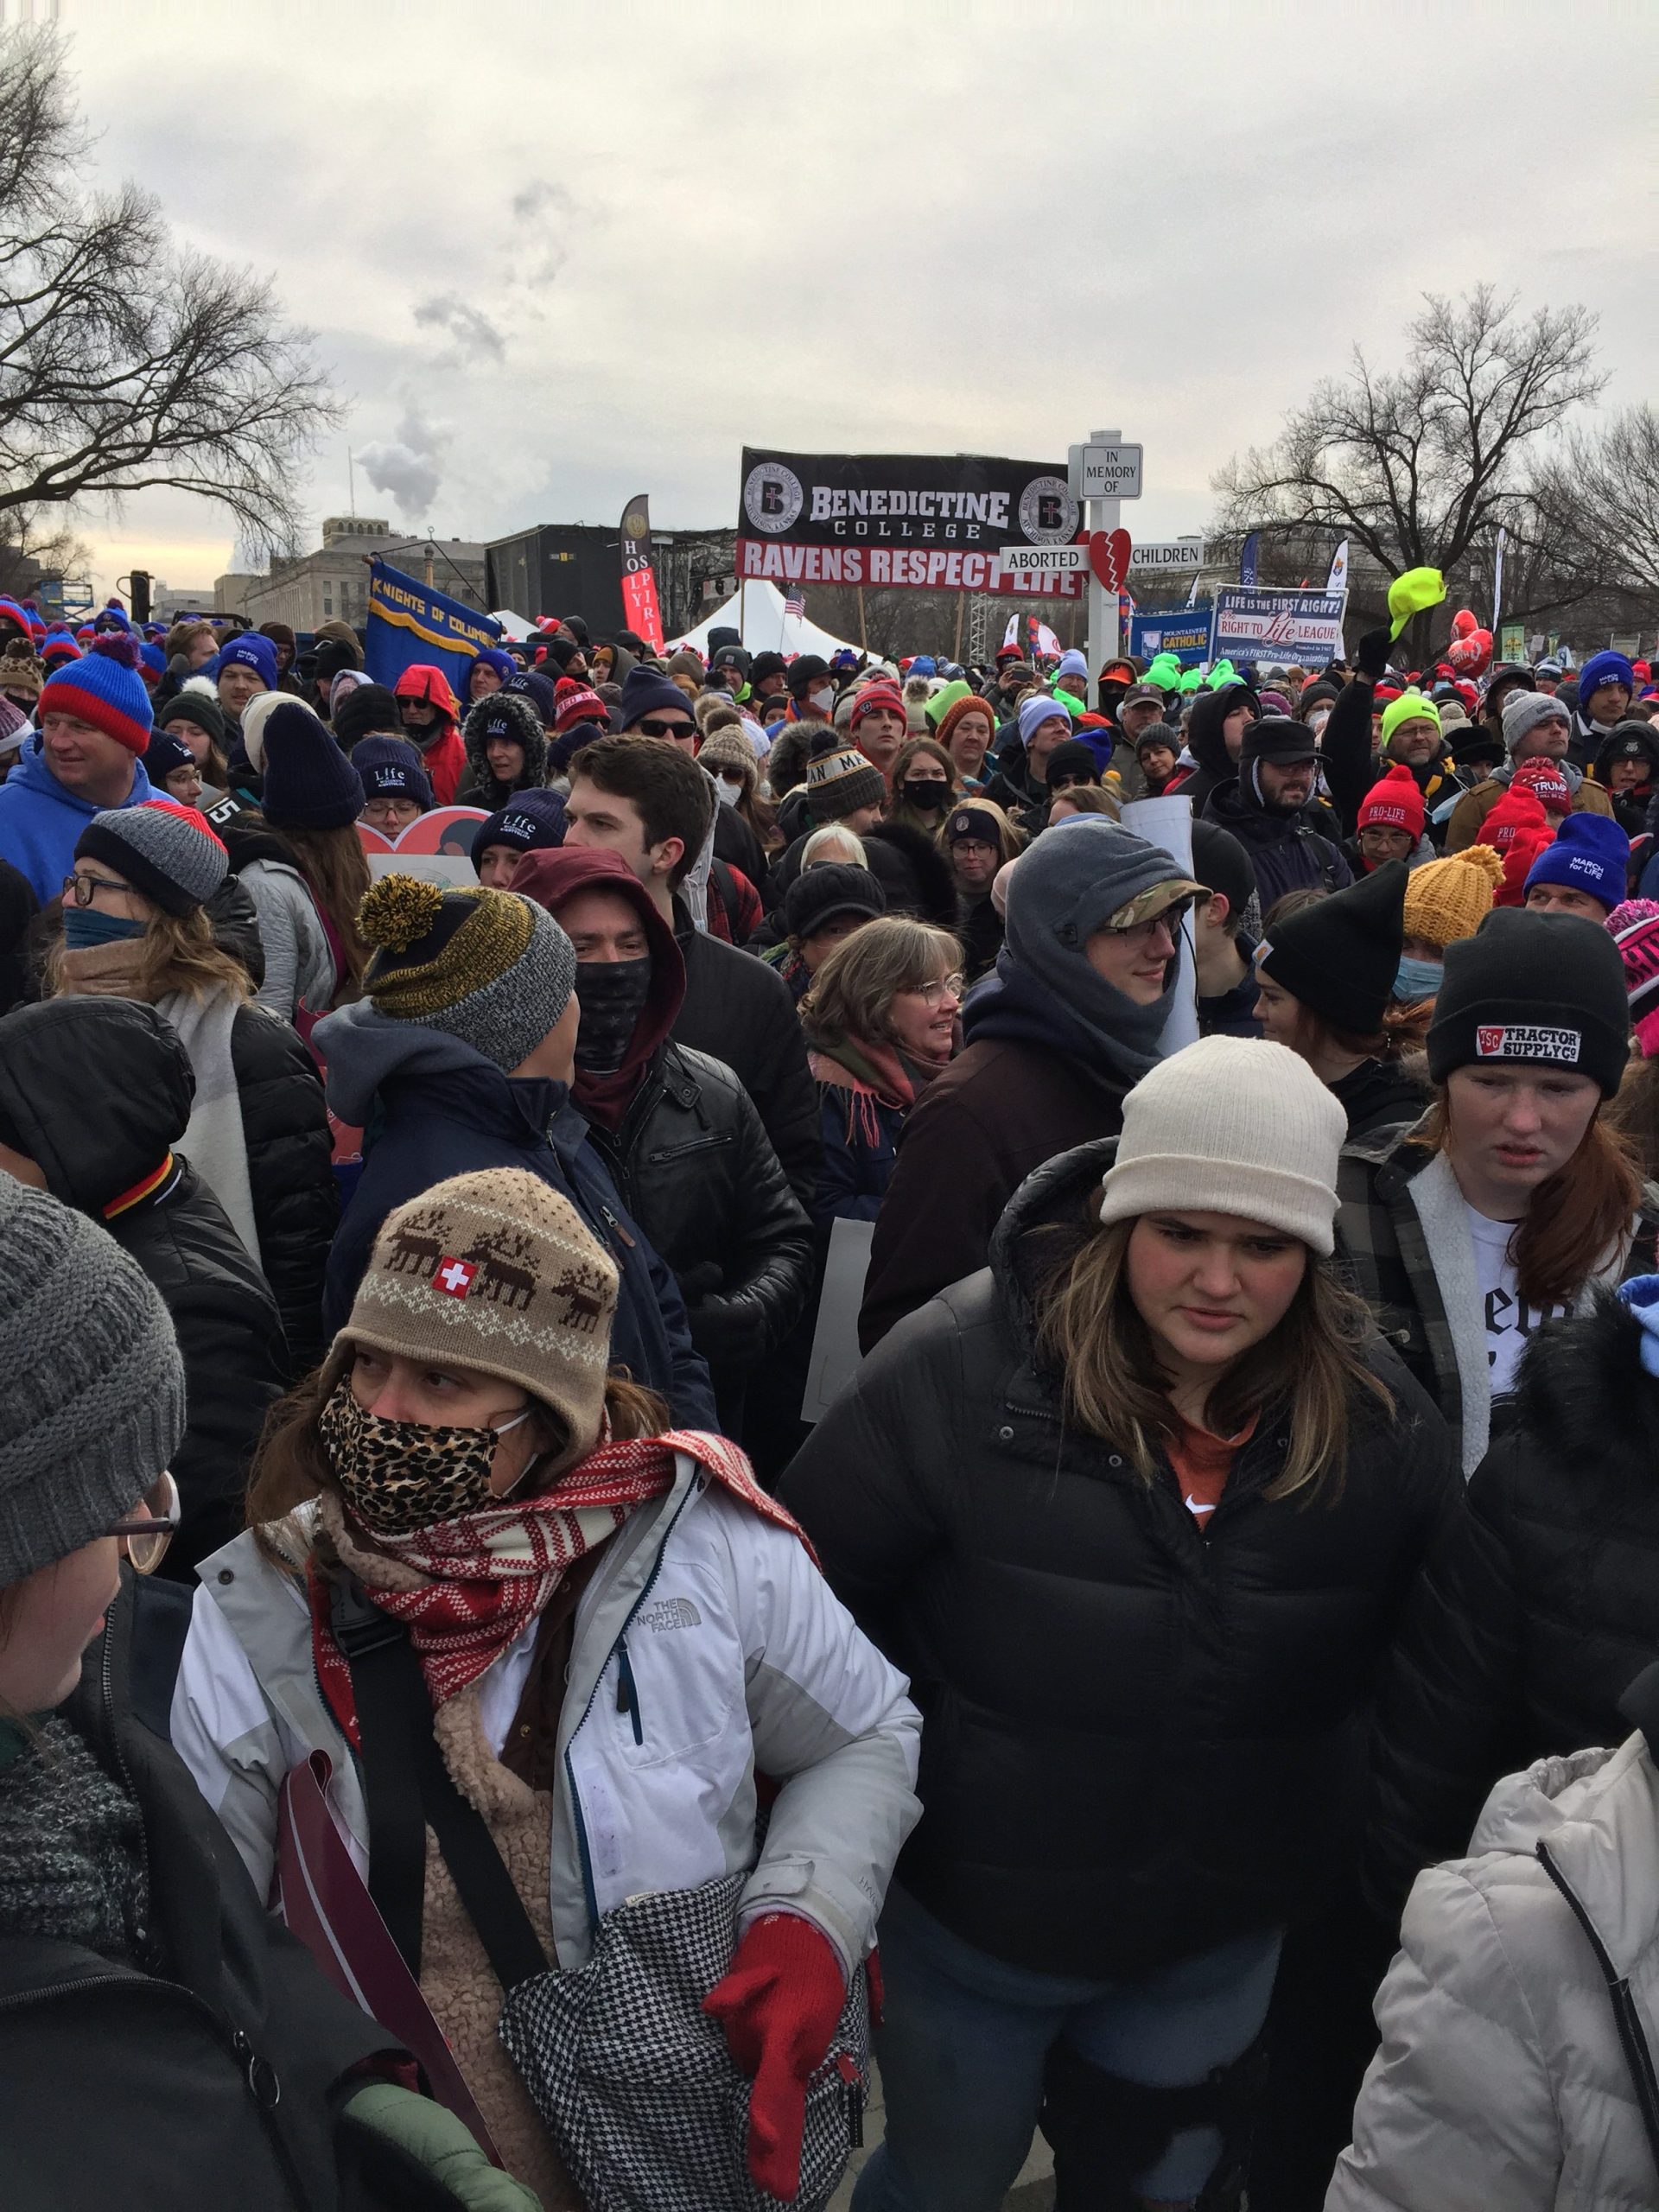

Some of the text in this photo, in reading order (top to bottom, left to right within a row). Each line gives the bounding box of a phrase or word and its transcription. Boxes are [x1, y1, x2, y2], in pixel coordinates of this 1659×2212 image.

[1106, 450, 1119, 463] IN
[1086, 466, 1136, 479] MEMORY
[1104, 480, 1119, 493] OF
[810, 486, 1010, 530] BENEDICTINE
[834, 520, 981, 540] COLLEGE
[744, 541, 862, 582] RAVENS
[869, 549, 1001, 589] RESPECT
[1008, 547, 1198, 569] ABORTED CHILDREN
[624, 540, 642, 607] HOLY
[372, 576, 426, 615] KNIGHTS
[432, 606, 446, 623] OF
[639, 554, 659, 656] SPIRIT
[1224, 595, 1341, 613] LIFE IS THE FIRST RIGHT!
[1221, 609, 1337, 647] RIGHT TO Life LEAGUE
[1162, 632, 1207, 649] CATHOLIC
[1219, 646, 1249, 657] America's
[1249, 648, 1267, 658] FIRST
[1268, 649, 1291, 661] Pro-Life
[1292, 652, 1330, 664] Organization
[1532, 781, 1567, 792] TRUMP
[1368, 805, 1407, 821] PRO-LIFE
[1497, 826, 1516, 838] PRO
[1569, 862, 1603, 880] for LIFE
[1572, 856, 1605, 874] MARCH
[1480, 1027, 1577, 1049] TSC TRACTOR
[653, 1598, 679, 1611] THE
[636, 1608, 680, 1626] NORTH
[651, 1618, 682, 1633] FACE
